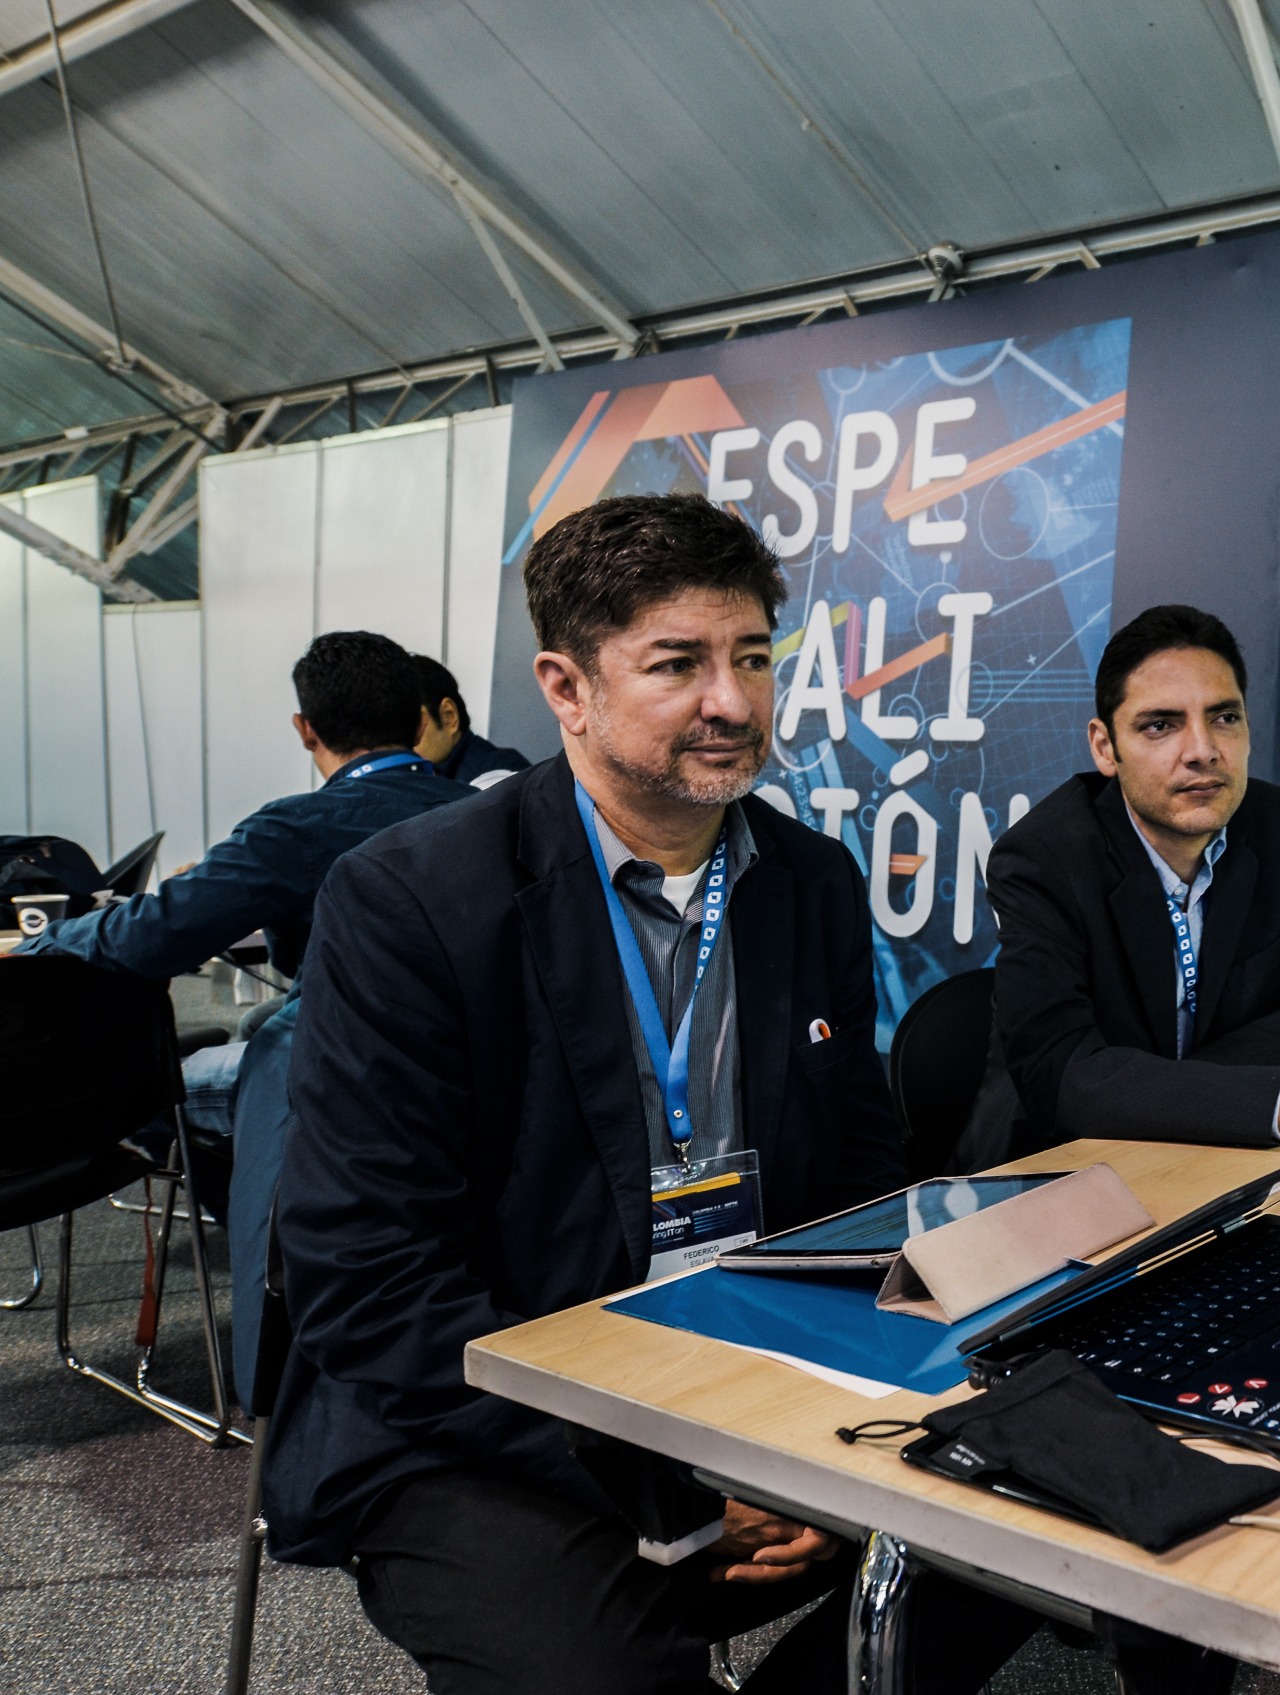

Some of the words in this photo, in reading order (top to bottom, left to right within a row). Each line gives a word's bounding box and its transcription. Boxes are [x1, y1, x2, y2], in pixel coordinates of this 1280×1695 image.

[781, 591, 993, 742] ALI
[652, 1216, 691, 1231] LOMBIA
[652, 1230, 667, 1240] ring
[683, 1245, 719, 1259] FEDERICO
